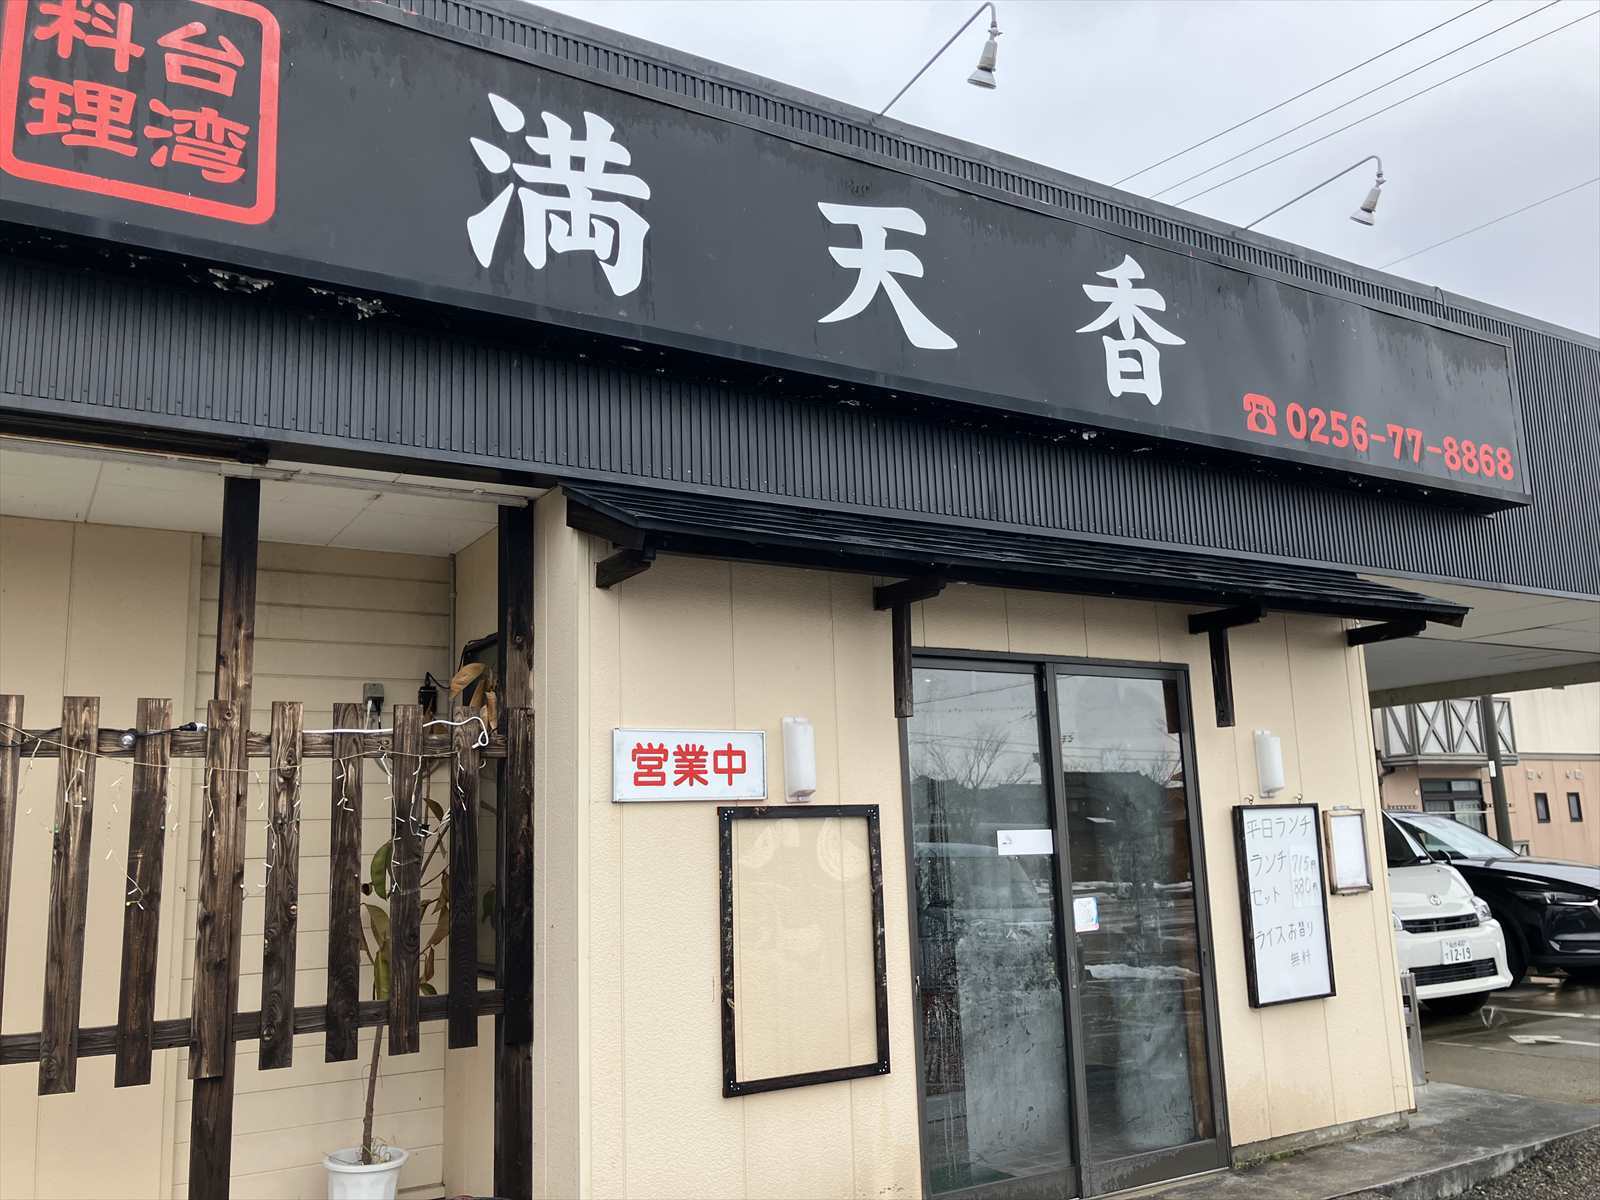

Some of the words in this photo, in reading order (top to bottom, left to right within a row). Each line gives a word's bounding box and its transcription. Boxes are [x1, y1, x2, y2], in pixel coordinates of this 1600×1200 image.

[25, 0, 146, 157] 料理
[143, 21, 251, 184] 台湾
[466, 92, 1187, 407] 満天香
[1286, 405, 1515, 482] 0256-77-8868
[631, 742, 747, 787] 営業中
[1246, 815, 1312, 839] 平日ランチ
[1250, 849, 1287, 877] ランチ
[1250, 886, 1281, 906] セット
